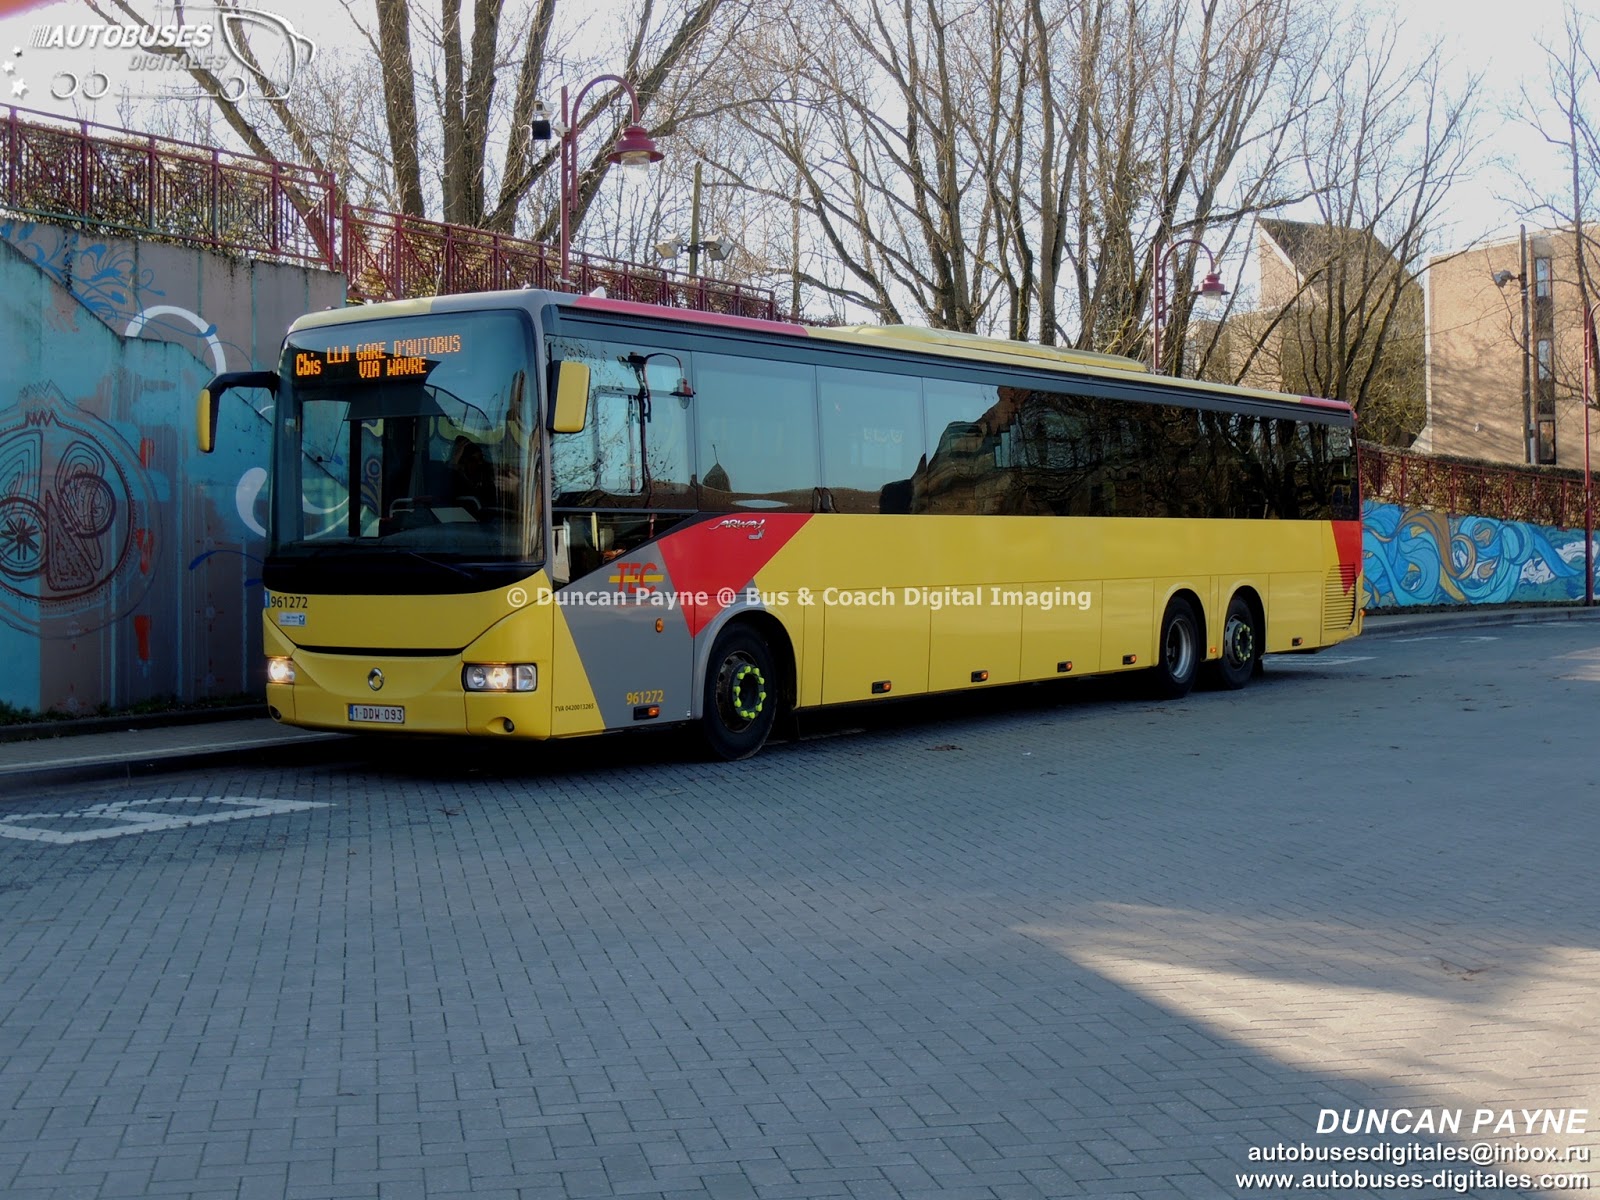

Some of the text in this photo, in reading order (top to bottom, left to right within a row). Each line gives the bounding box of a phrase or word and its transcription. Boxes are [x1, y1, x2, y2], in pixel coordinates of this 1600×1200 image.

[326, 334, 461, 364] LLN GARE D'AUTOBUS
[358, 356, 427, 379] VIA WAVRE
[615, 562, 658, 594] TEC
[270, 596, 308, 609] 961272
[626, 690, 664, 705] 961272
